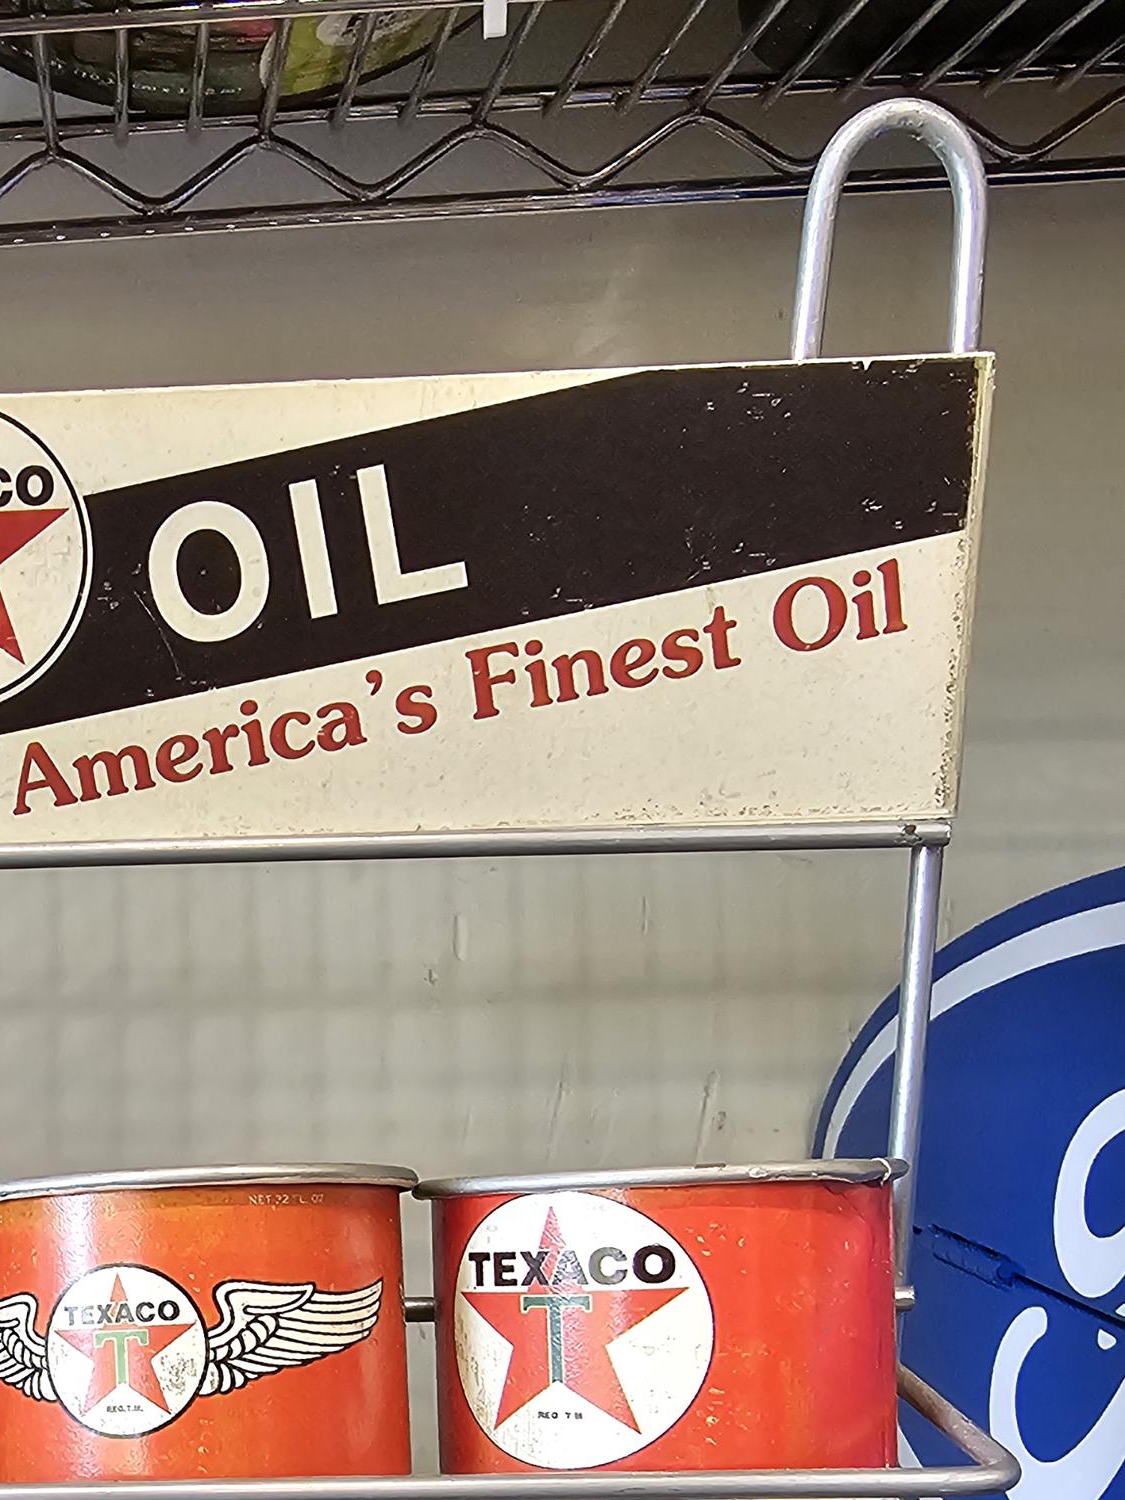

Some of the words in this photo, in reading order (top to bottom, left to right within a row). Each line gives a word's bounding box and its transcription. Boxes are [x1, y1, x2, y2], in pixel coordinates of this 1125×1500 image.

[146, 463, 469, 645] OIL
[12, 668, 438, 818] America's
[464, 603, 741, 721] Finest
[771, 558, 910, 655] Oil
[468, 1244, 676, 1287] TEXACO
[63, 1300, 177, 1327] TEXACO
[520, 1293, 593, 1385] T
[93, 1329, 150, 1385] T
